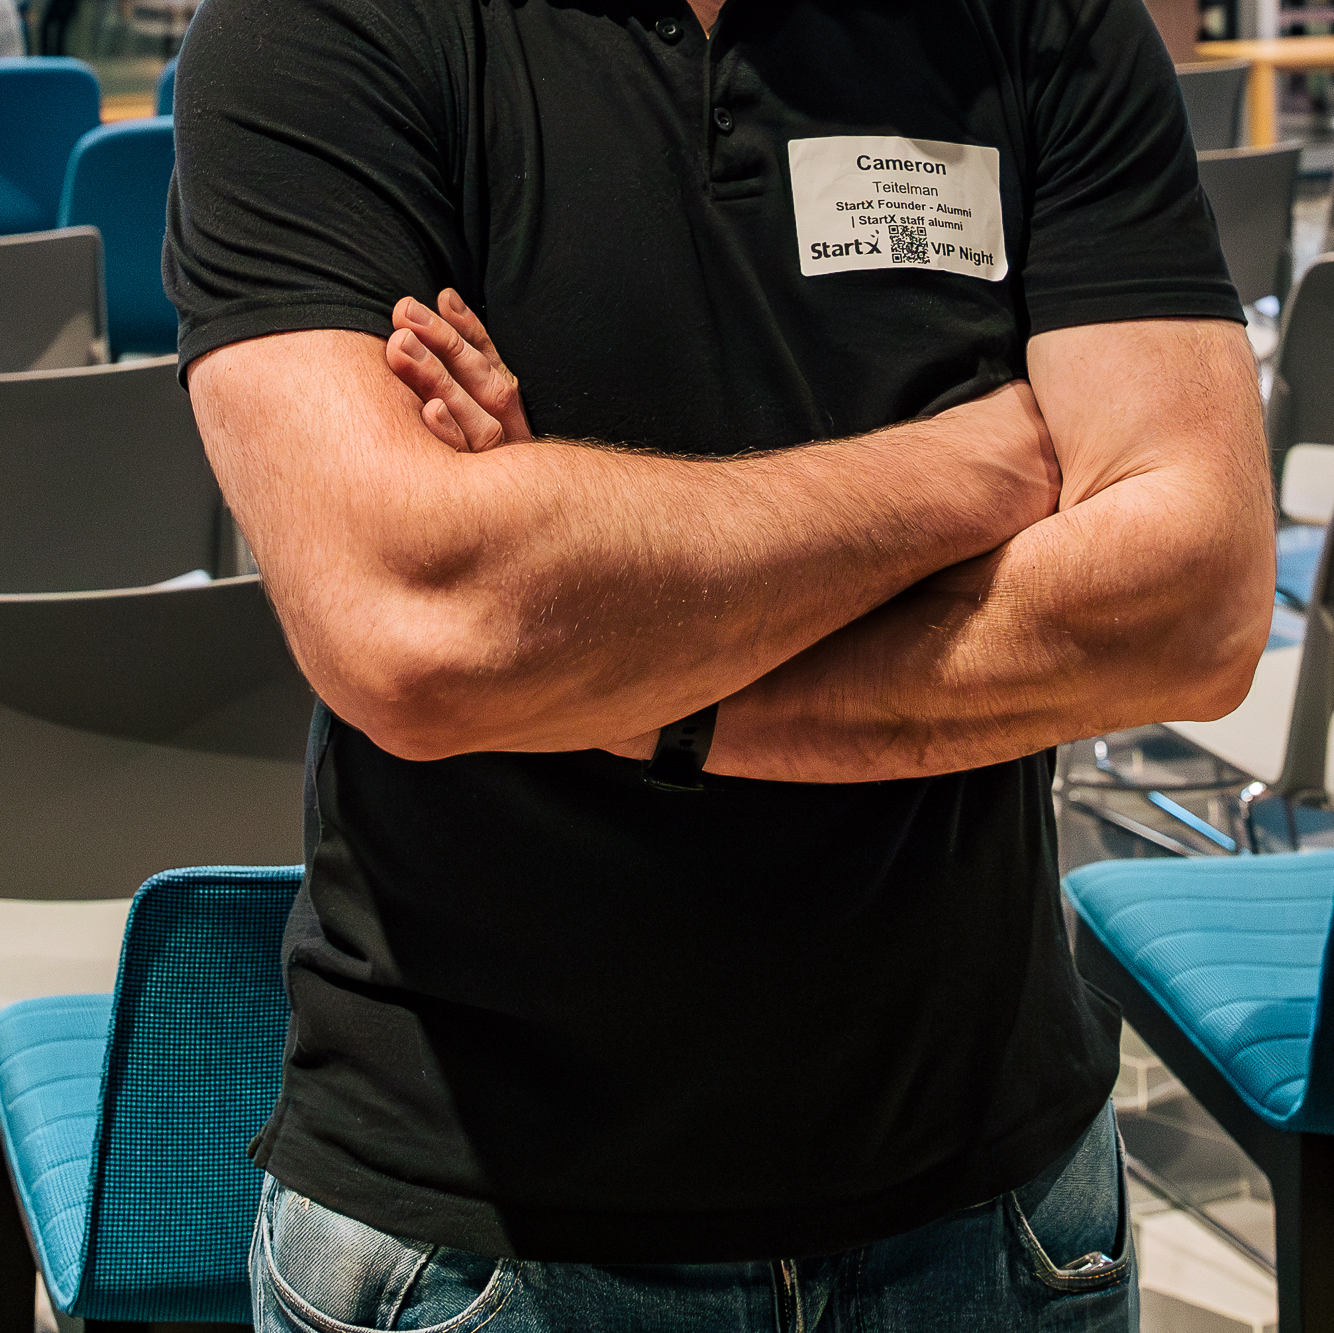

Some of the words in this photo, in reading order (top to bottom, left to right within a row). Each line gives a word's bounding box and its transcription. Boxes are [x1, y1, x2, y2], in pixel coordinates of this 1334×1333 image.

[856, 154, 947, 175] Cameron
[872, 181, 939, 197] Teitelman
[835, 199, 875, 211] StartX
[877, 199, 927, 211] Founder
[936, 203, 972, 218] Alumni
[858, 214, 897, 225] StartX
[899, 216, 925, 226] staff
[928, 217, 964, 231] alumni
[930, 242, 956, 257] VIP
[959, 246, 995, 266] Night
